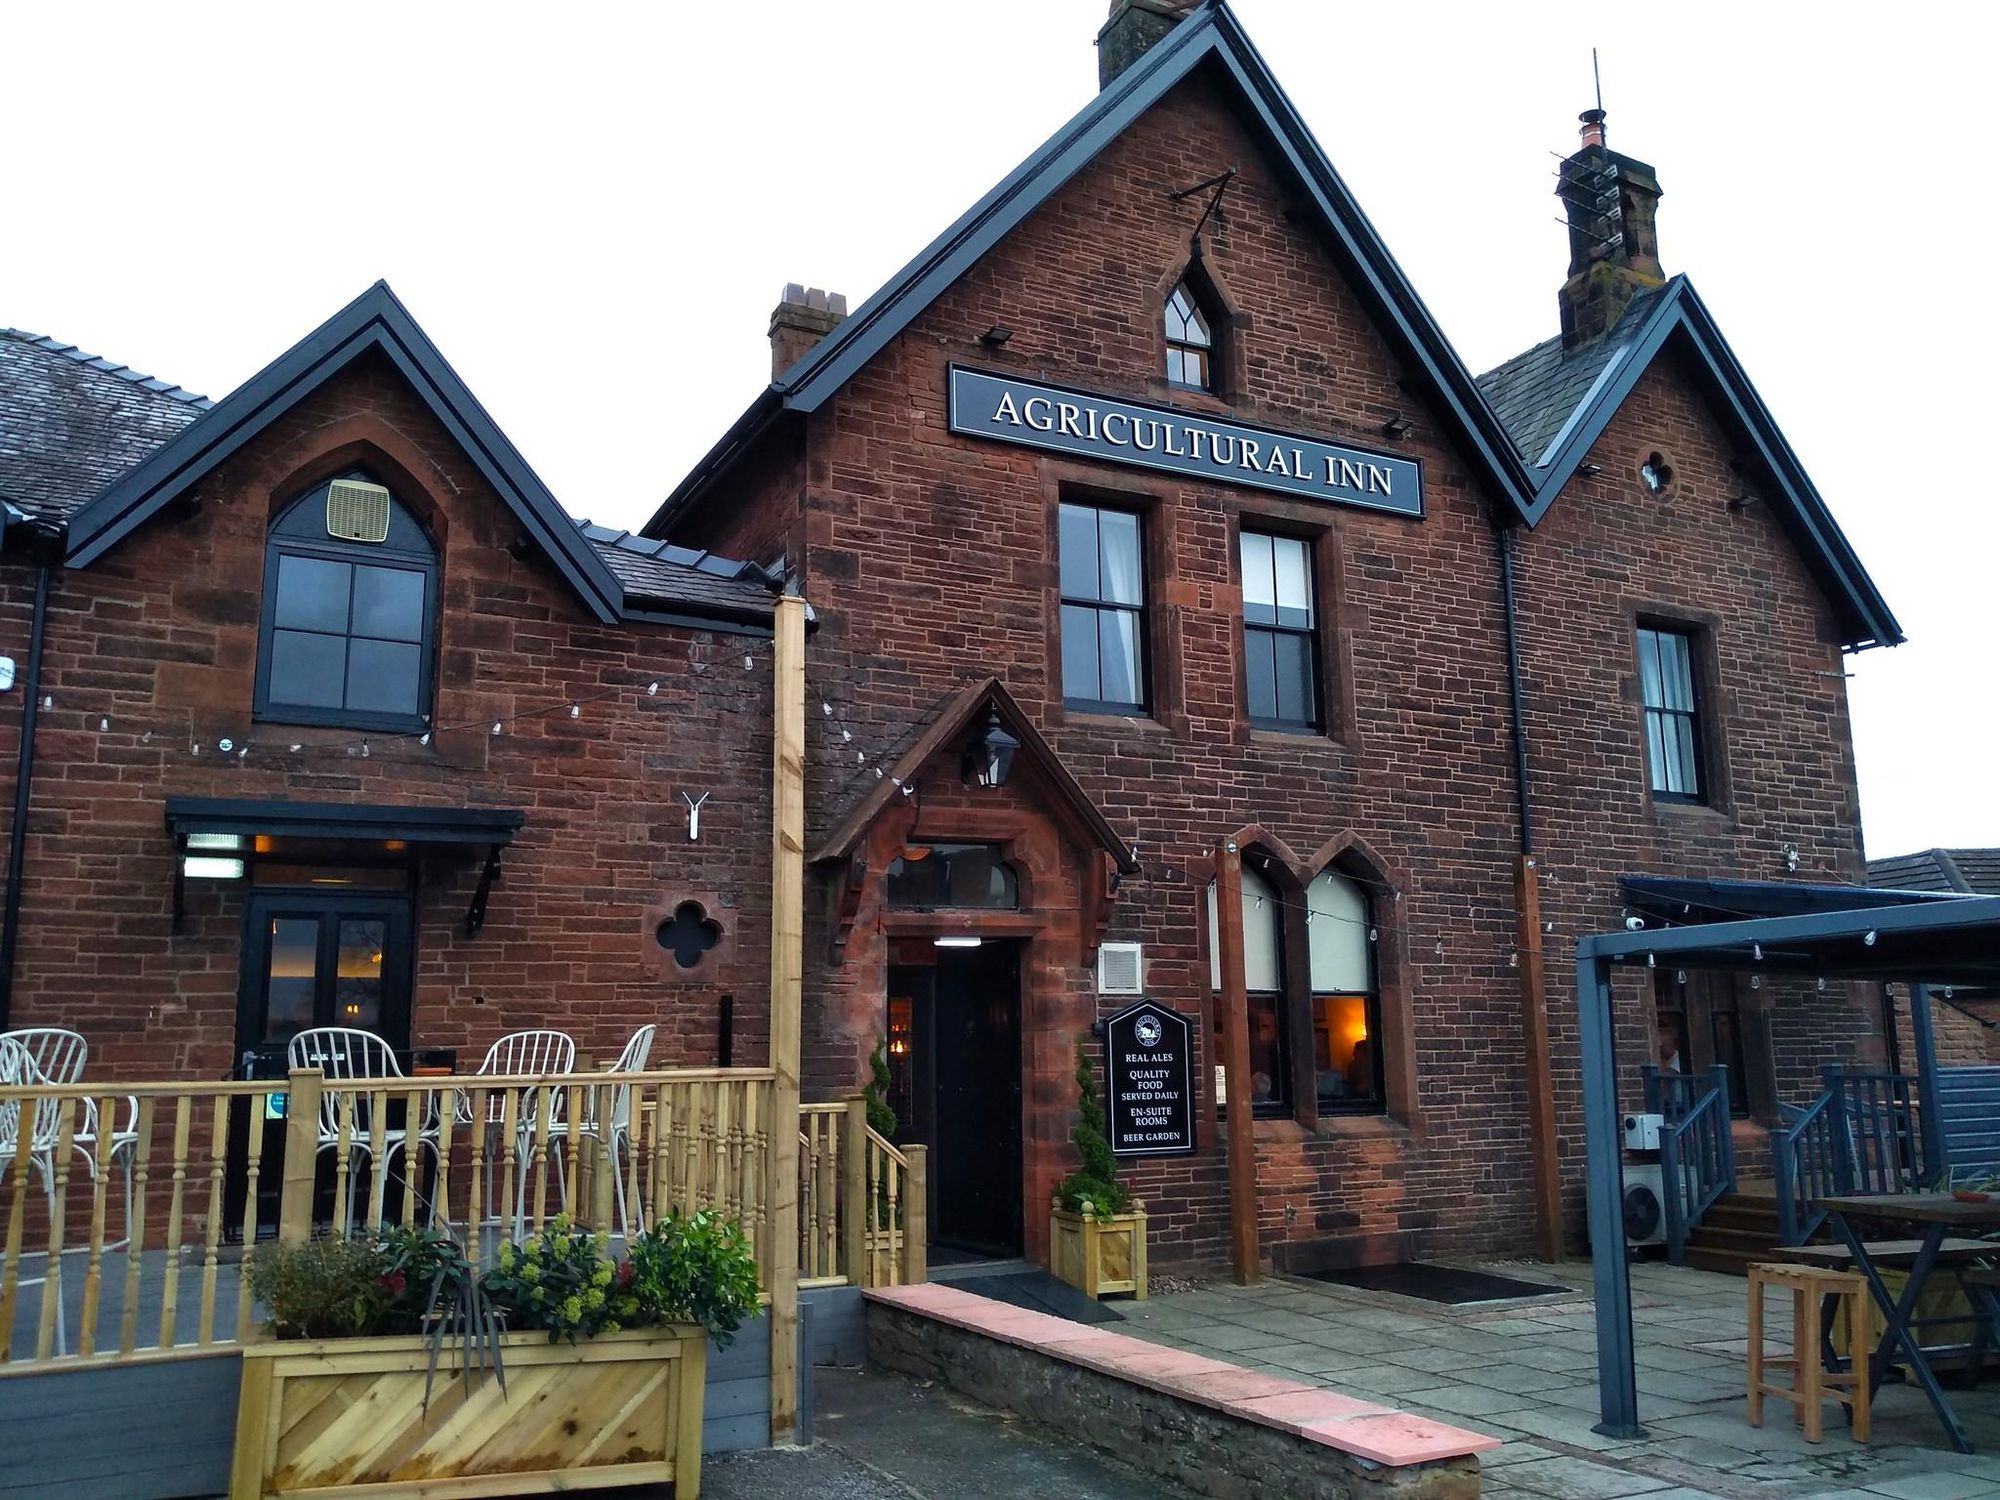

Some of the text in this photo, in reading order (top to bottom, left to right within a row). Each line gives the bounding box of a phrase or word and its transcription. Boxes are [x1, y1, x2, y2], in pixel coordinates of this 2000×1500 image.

[991, 391, 1393, 496] AGRICULTURAL INN
[1125, 1053, 1173, 1062] REAL ALES
[1129, 1070, 1170, 1080] QUALITY
[1137, 1081, 1163, 1090] FOOD
[1121, 1091, 1179, 1101] SERVED DAILY
[1130, 1106, 1172, 1117] EN-SUITE
[1135, 1116, 1168, 1126] ROOMS
[1123, 1131, 1180, 1142] BEER GARDEN
